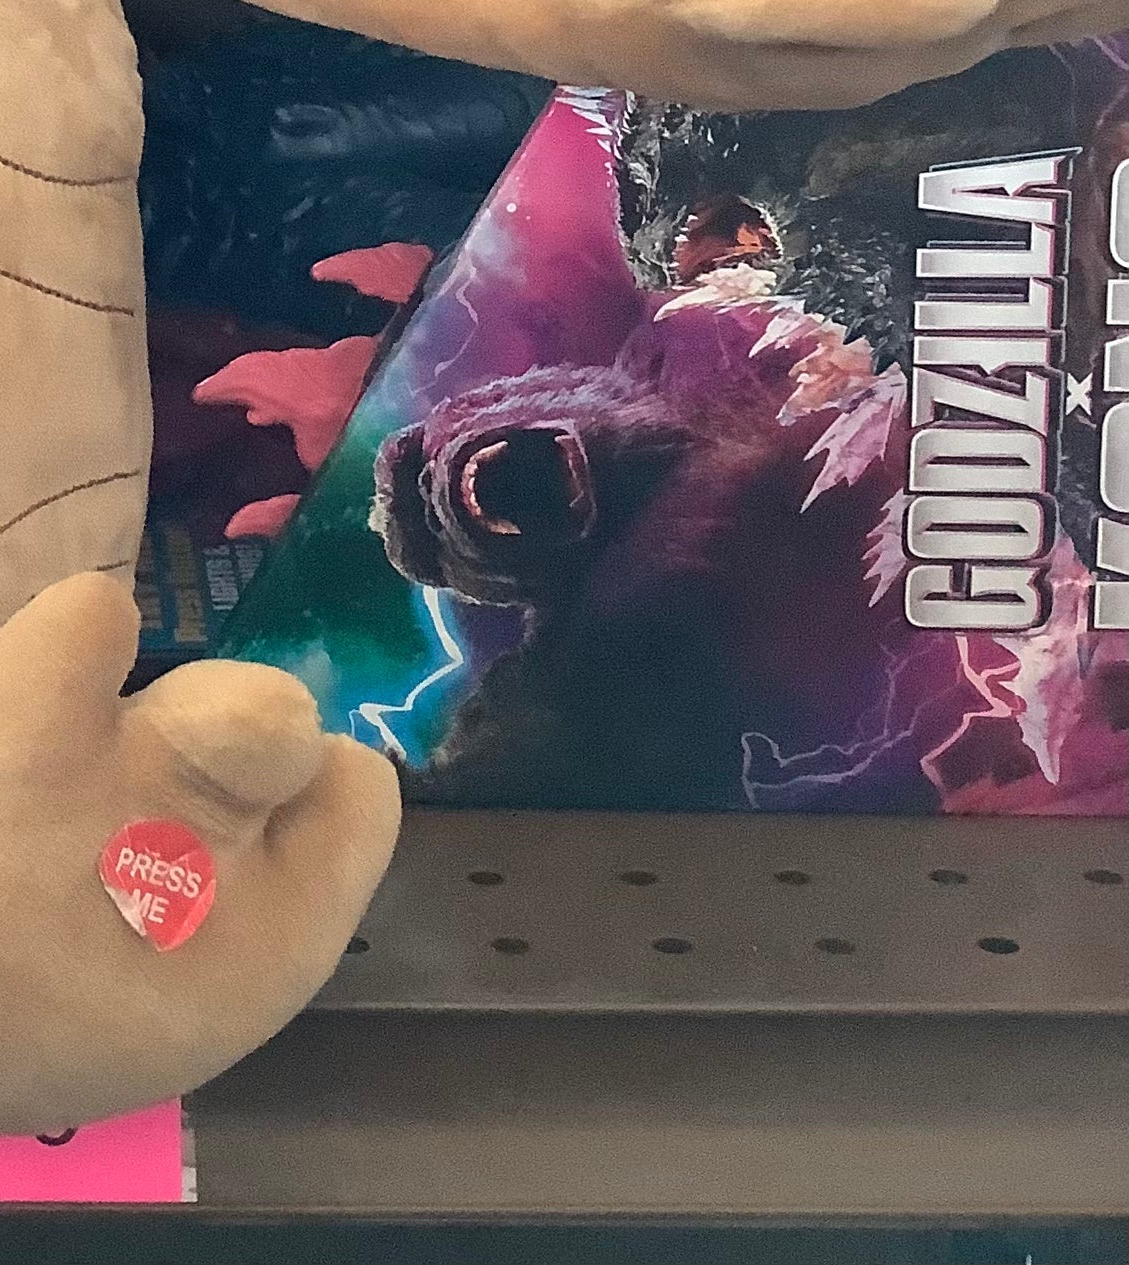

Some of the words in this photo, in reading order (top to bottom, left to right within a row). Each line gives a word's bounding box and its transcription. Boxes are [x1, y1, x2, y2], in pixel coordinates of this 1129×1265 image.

[904, 152, 1066, 631] GODZILLA
[115, 847, 203, 899] PRESS
[130, 888, 170, 924] ME
